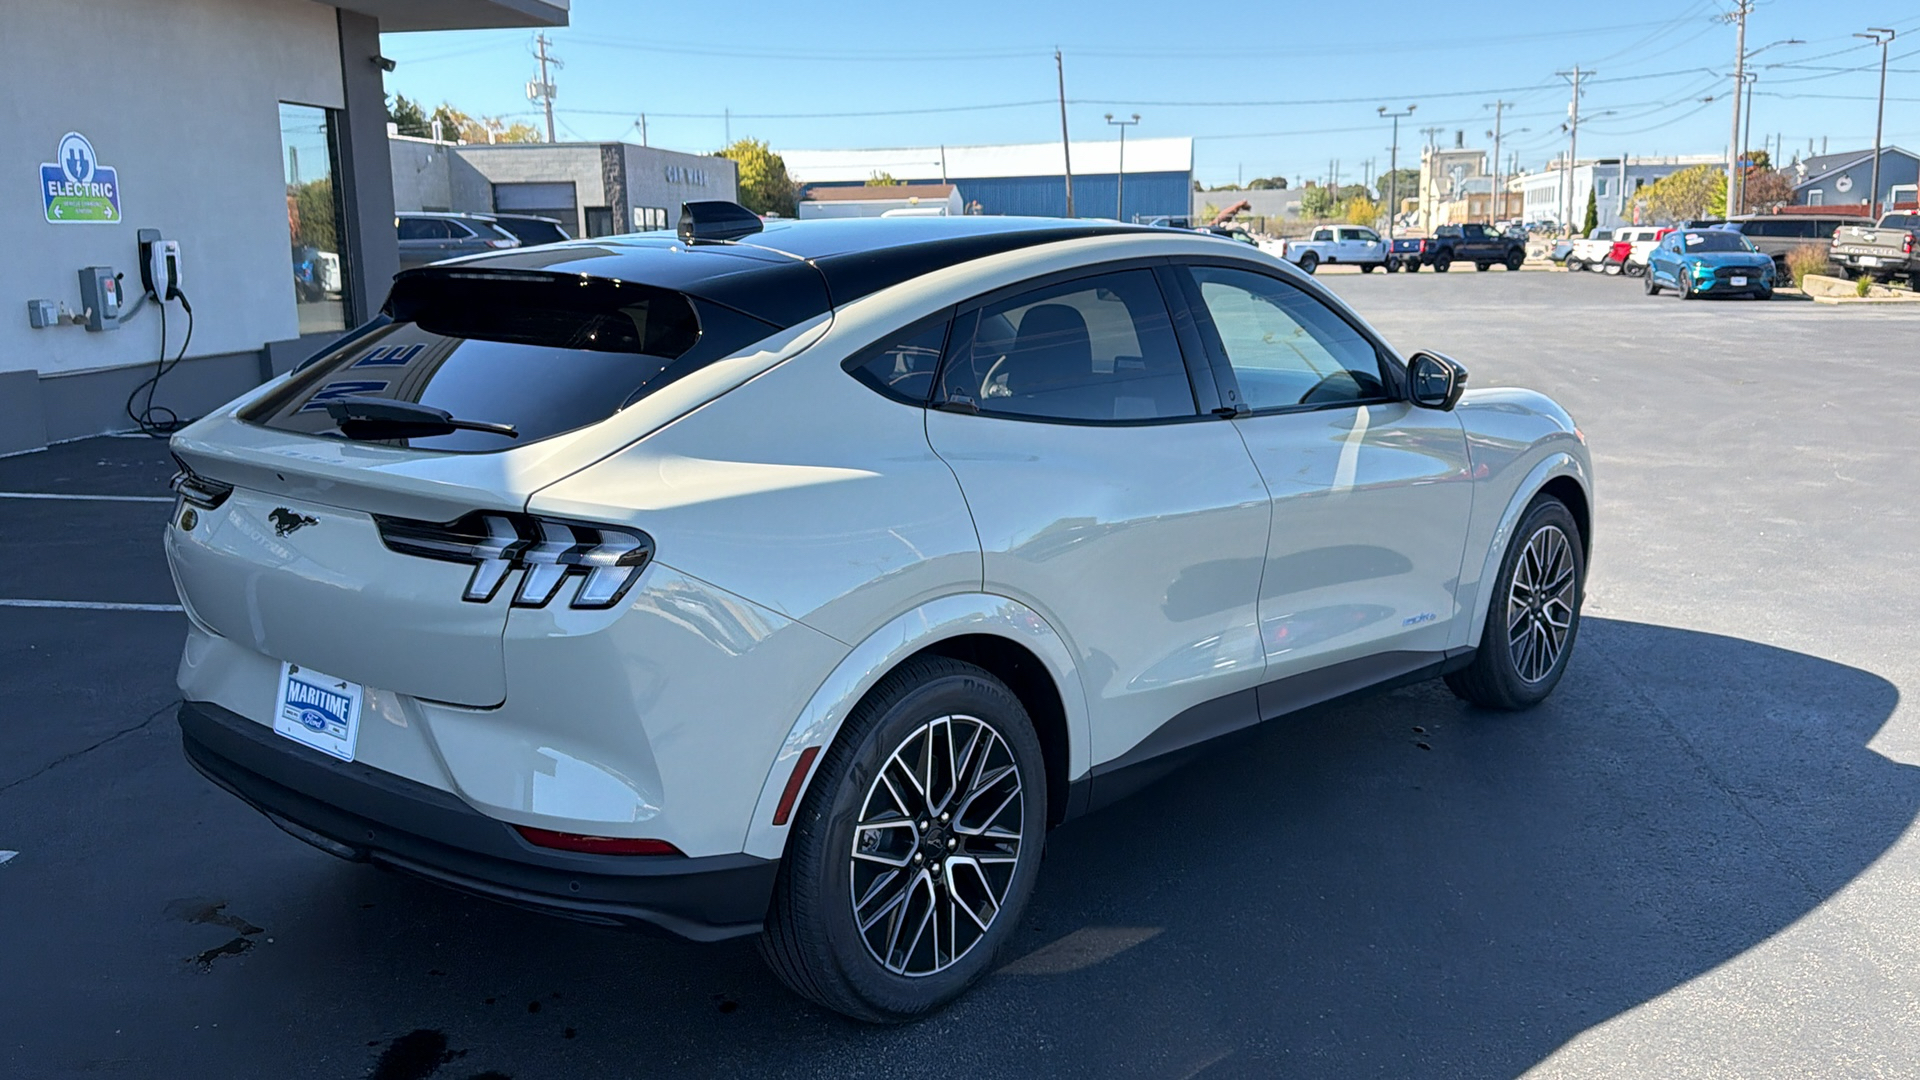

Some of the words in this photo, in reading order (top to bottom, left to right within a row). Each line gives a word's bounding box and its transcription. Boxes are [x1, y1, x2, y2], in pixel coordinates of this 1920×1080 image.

[48, 181, 113, 198] ELECTRIC
[287, 680, 349, 723] MARITIME
[305, 712, 323, 729] Ford
